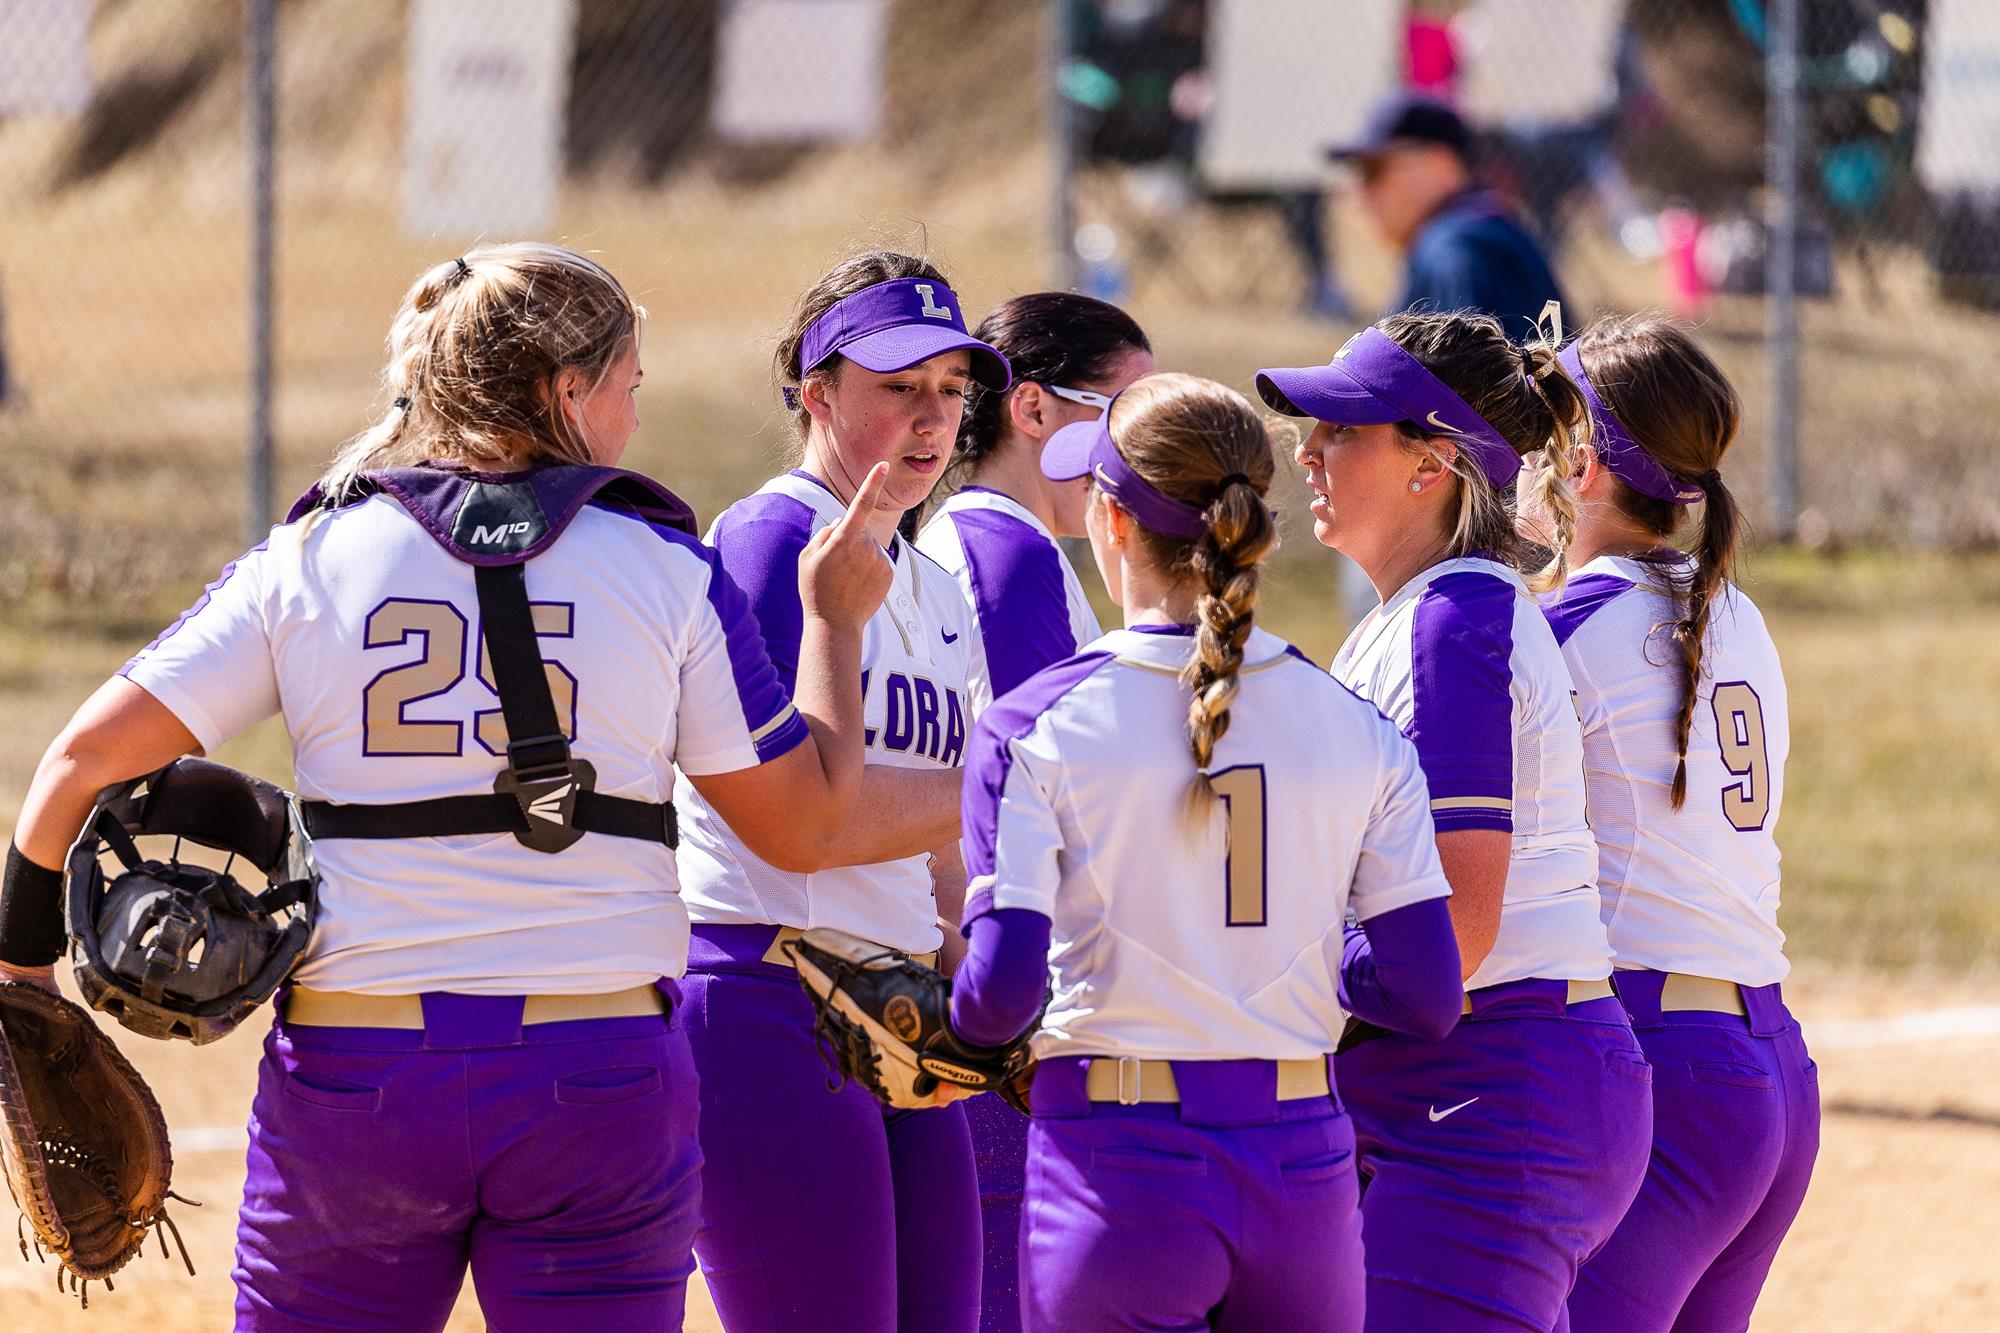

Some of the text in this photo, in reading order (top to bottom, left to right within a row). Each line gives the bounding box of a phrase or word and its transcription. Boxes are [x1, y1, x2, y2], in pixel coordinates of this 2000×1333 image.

[915, 284, 952, 320] L
[362, 597, 578, 757] 25
[861, 667, 965, 768] ORA
[1710, 680, 1769, 832] 9
[1208, 763, 1267, 927] 1
